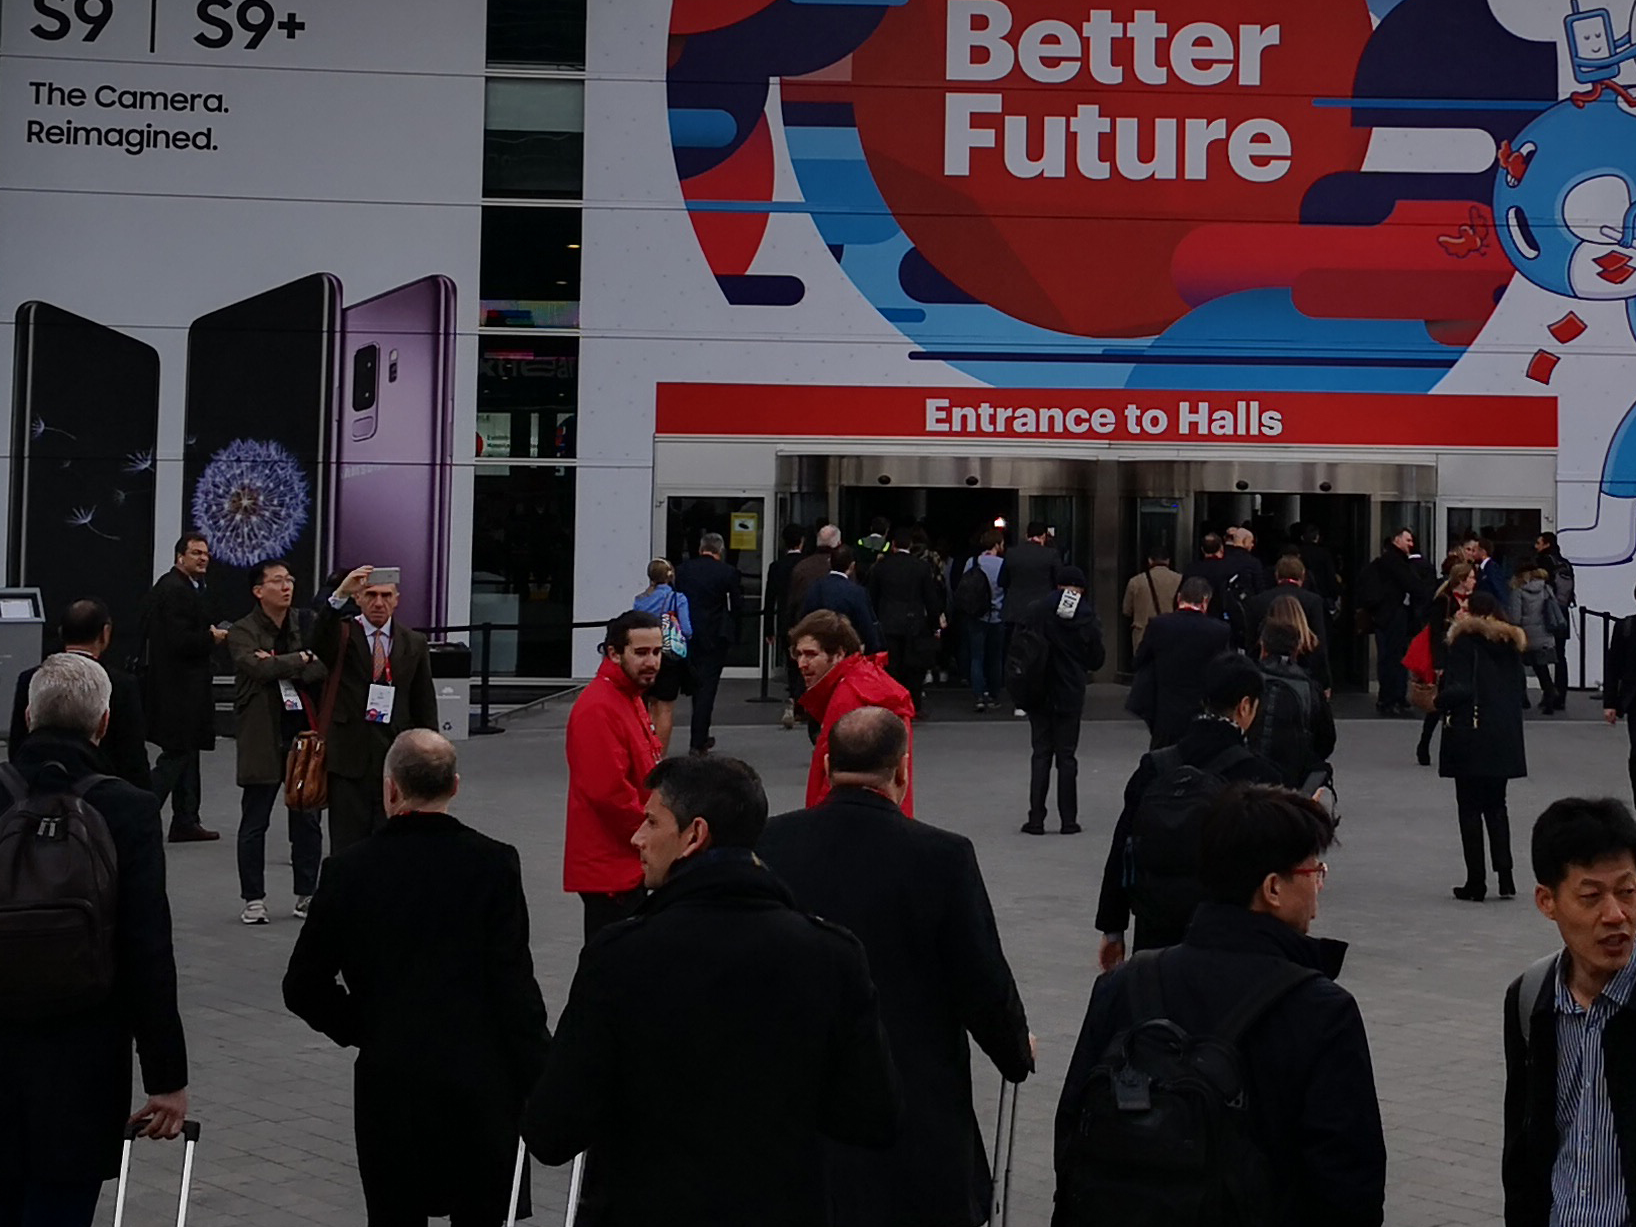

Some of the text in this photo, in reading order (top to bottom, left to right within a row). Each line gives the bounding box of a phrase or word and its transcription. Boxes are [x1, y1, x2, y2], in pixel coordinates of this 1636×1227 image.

[28, 81, 229, 114] The Camera.
[26, 119, 219, 156] Reimagined.
[944, 92, 1292, 183] Future
[925, 398, 1283, 436] Entrance to Halls
